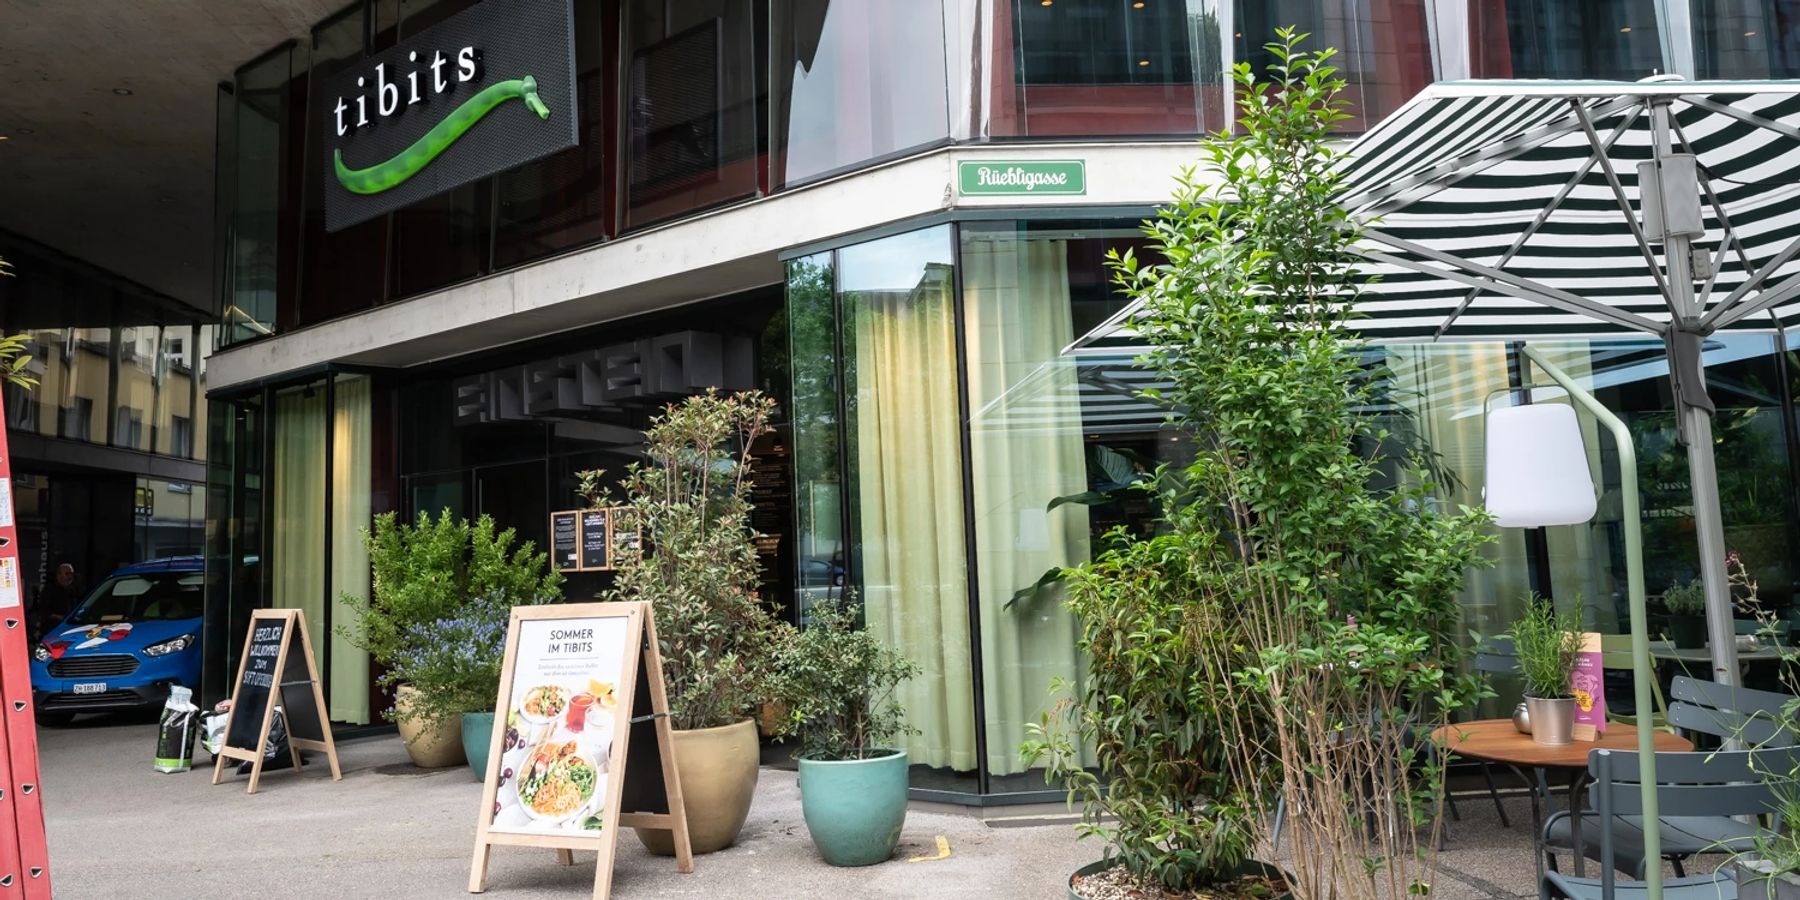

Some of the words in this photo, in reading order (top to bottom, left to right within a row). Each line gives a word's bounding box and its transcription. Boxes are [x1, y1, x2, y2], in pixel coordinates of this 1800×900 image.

[334, 46, 476, 136] tibits
[977, 166, 1068, 191] Rüebligasse
[254, 626, 282, 641] HERZLICH
[550, 628, 593, 640] SOMMER
[548, 643, 560, 653] IM
[564, 641, 593, 653] TIBITS
[254, 659, 268, 669] ZUM
